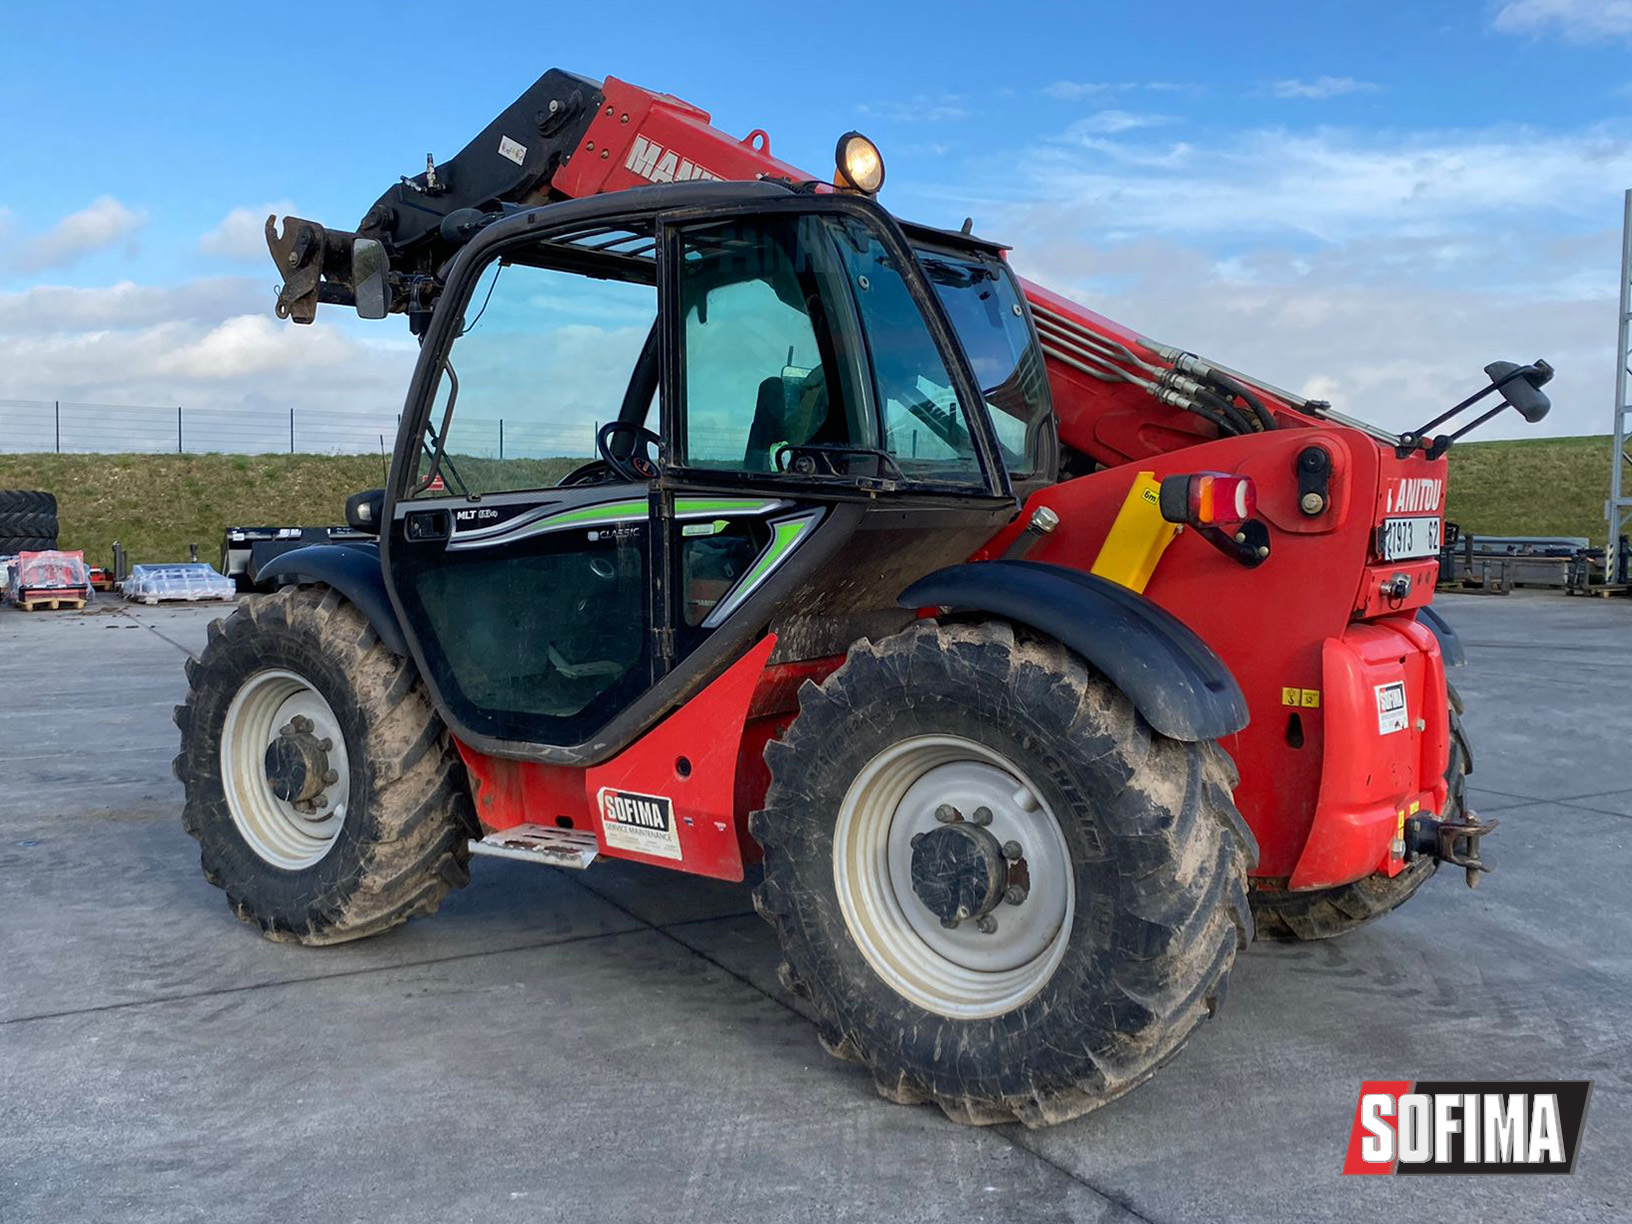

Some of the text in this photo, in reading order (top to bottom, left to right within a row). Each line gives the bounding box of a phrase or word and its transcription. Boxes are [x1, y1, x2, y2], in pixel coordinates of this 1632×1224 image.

[457, 510, 477, 520] MLT
[1428, 520, 1439, 550] 62
[605, 795, 664, 829] SOFIMA
